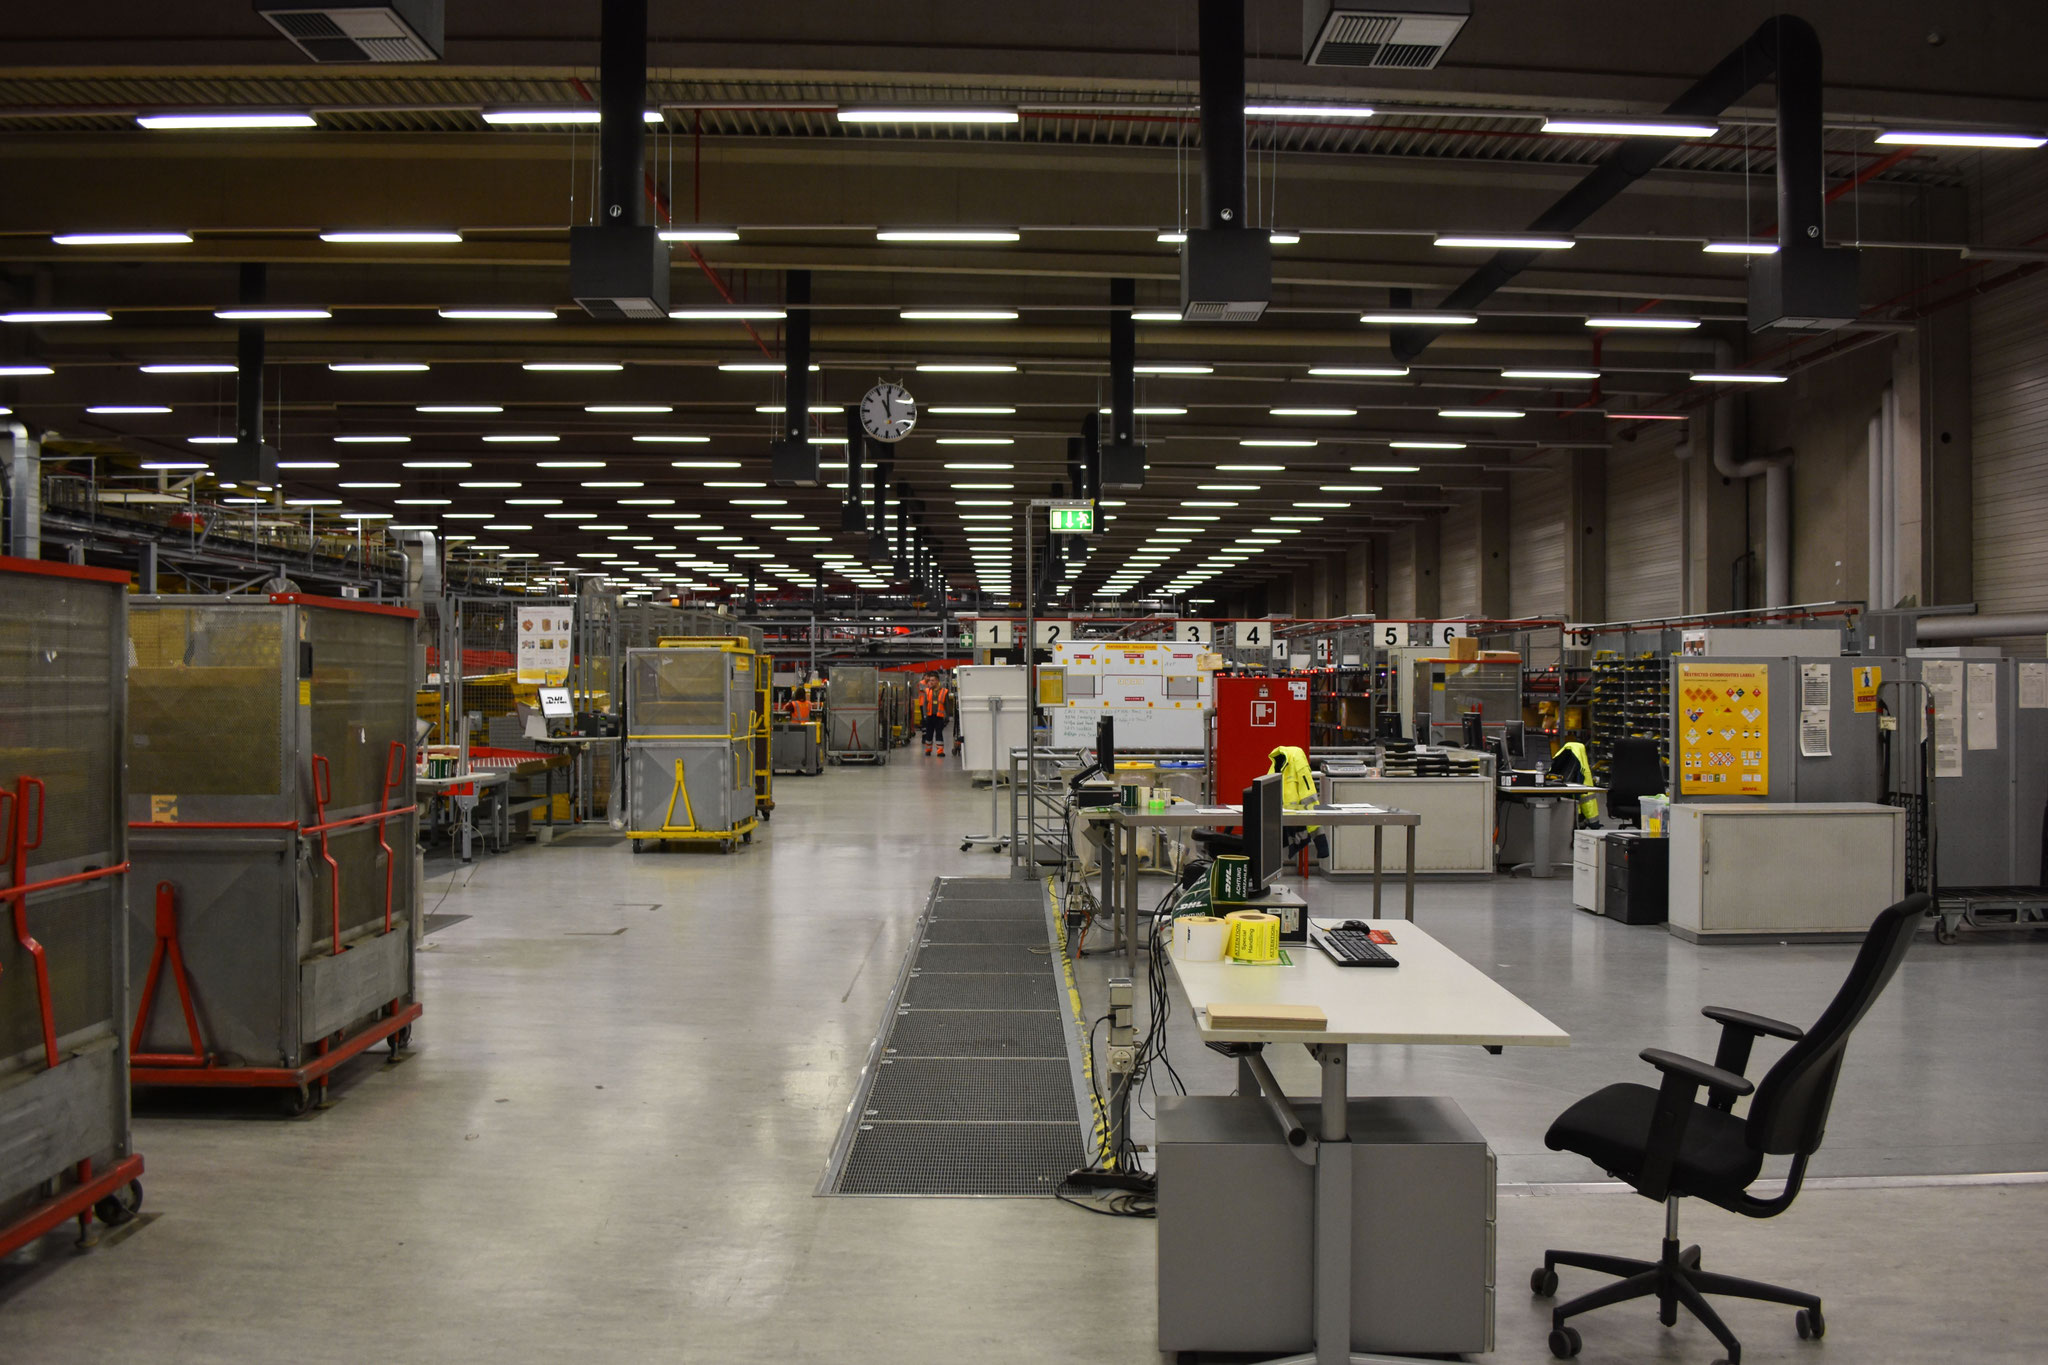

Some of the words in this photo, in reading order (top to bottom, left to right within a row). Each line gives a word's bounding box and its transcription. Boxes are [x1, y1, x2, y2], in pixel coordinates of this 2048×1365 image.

[989, 625, 998, 643] 1
[1047, 625, 1060, 644] 2
[1187, 626, 1200, 642] 3
[1246, 626, 1260, 644] 4
[1384, 627, 1397, 645] 5
[1443, 626, 1455, 645] 6
[546, 696, 567, 704] DHL
[1176, 901, 1208, 911] DHL
